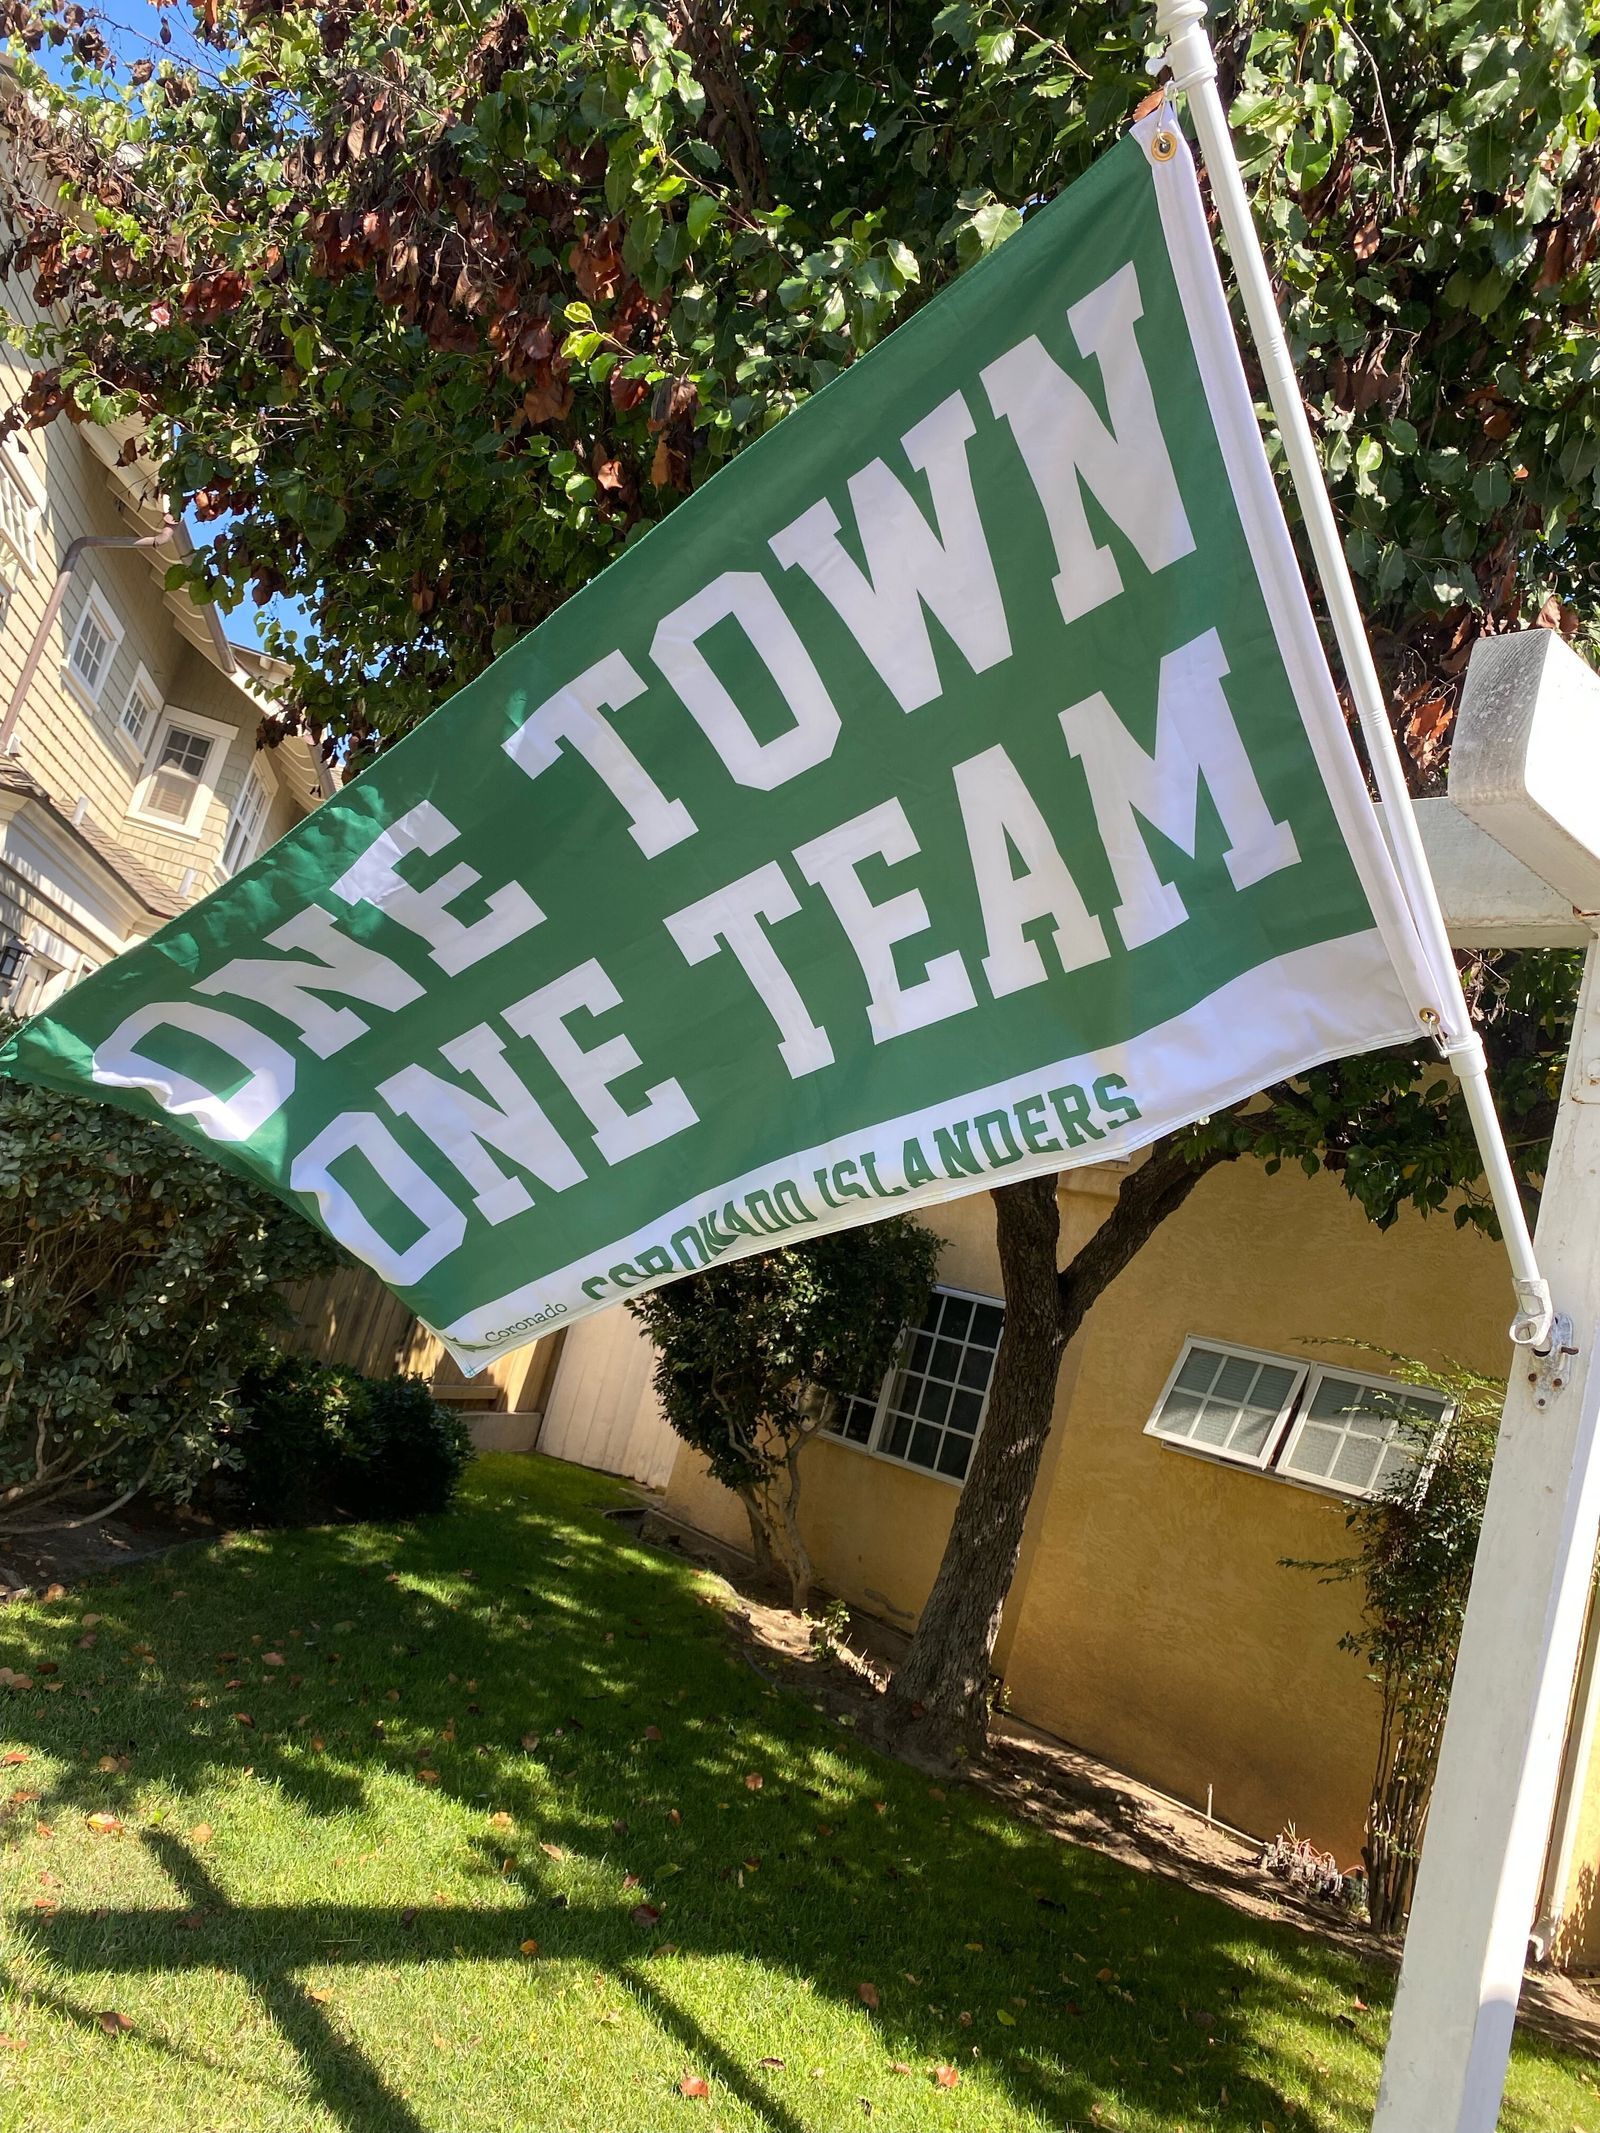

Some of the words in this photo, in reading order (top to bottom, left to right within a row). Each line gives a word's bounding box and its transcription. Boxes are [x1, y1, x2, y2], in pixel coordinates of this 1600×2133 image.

[92, 799, 547, 1142] ONE
[501, 260, 1197, 860] TOWN
[290, 957, 701, 1287] ONE
[662, 626, 1302, 1080] TEAM
[812, 1072, 1143, 1209] ISLANDERS
[484, 1302, 568, 1343] Coronado
